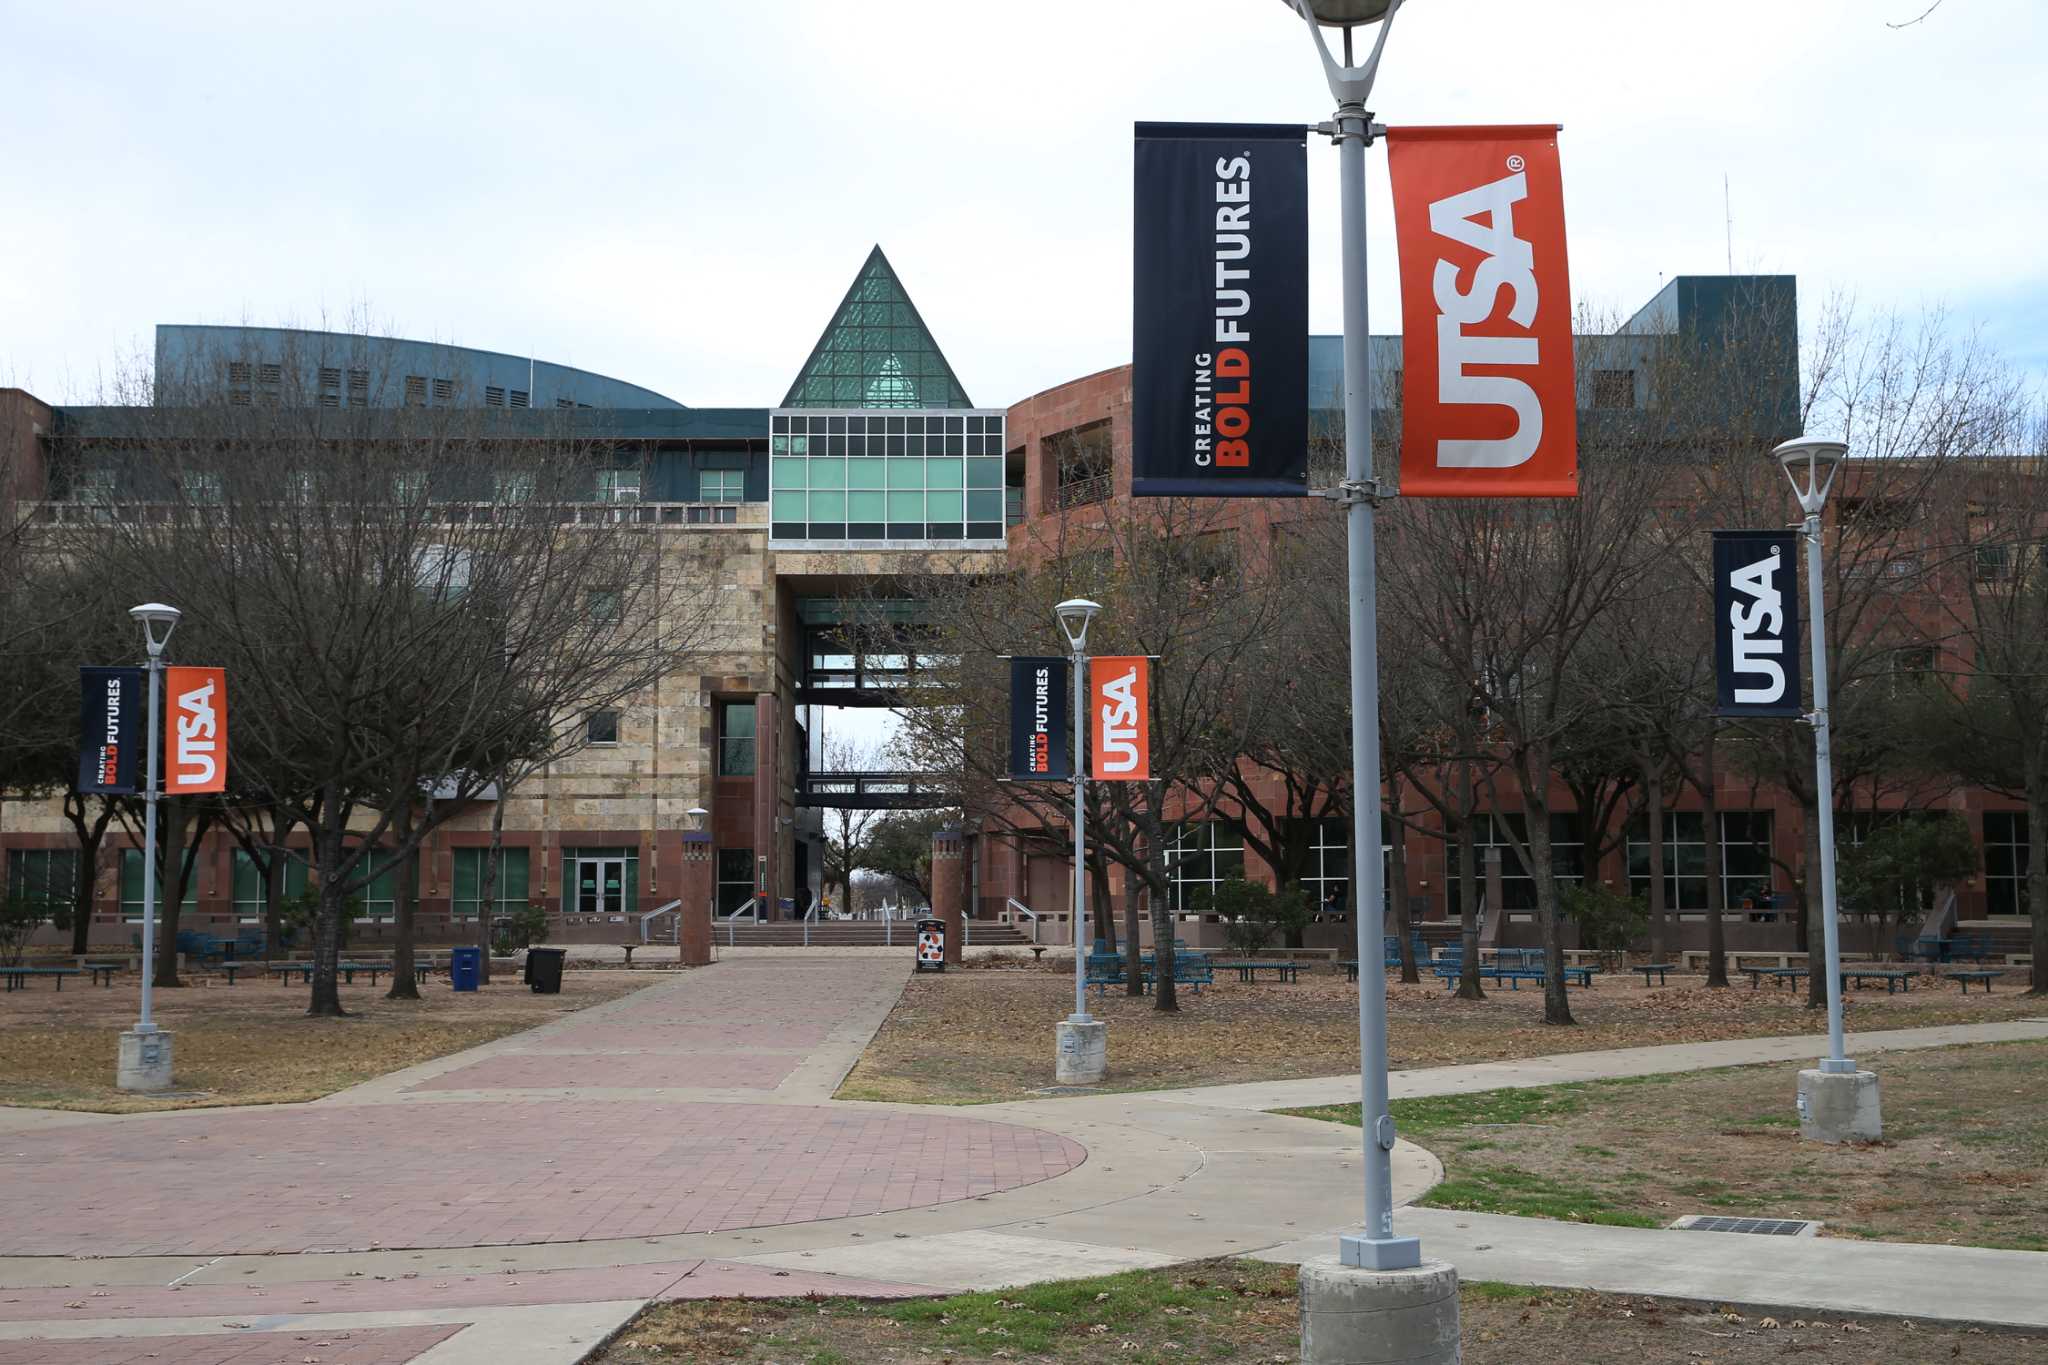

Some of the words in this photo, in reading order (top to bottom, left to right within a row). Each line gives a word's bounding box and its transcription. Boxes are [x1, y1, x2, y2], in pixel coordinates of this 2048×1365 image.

[1195, 353, 1212, 467] CREATING
[1215, 347, 1251, 467] BOLD
[107, 679, 120, 744] FUTURES
[1036, 668, 1049, 732] FUTURES
[97, 746, 106, 784] CREATING
[105, 744, 118, 785] BOLD
[1028, 735, 1036, 772] CREATING
[1036, 732, 1049, 772] BOLD
